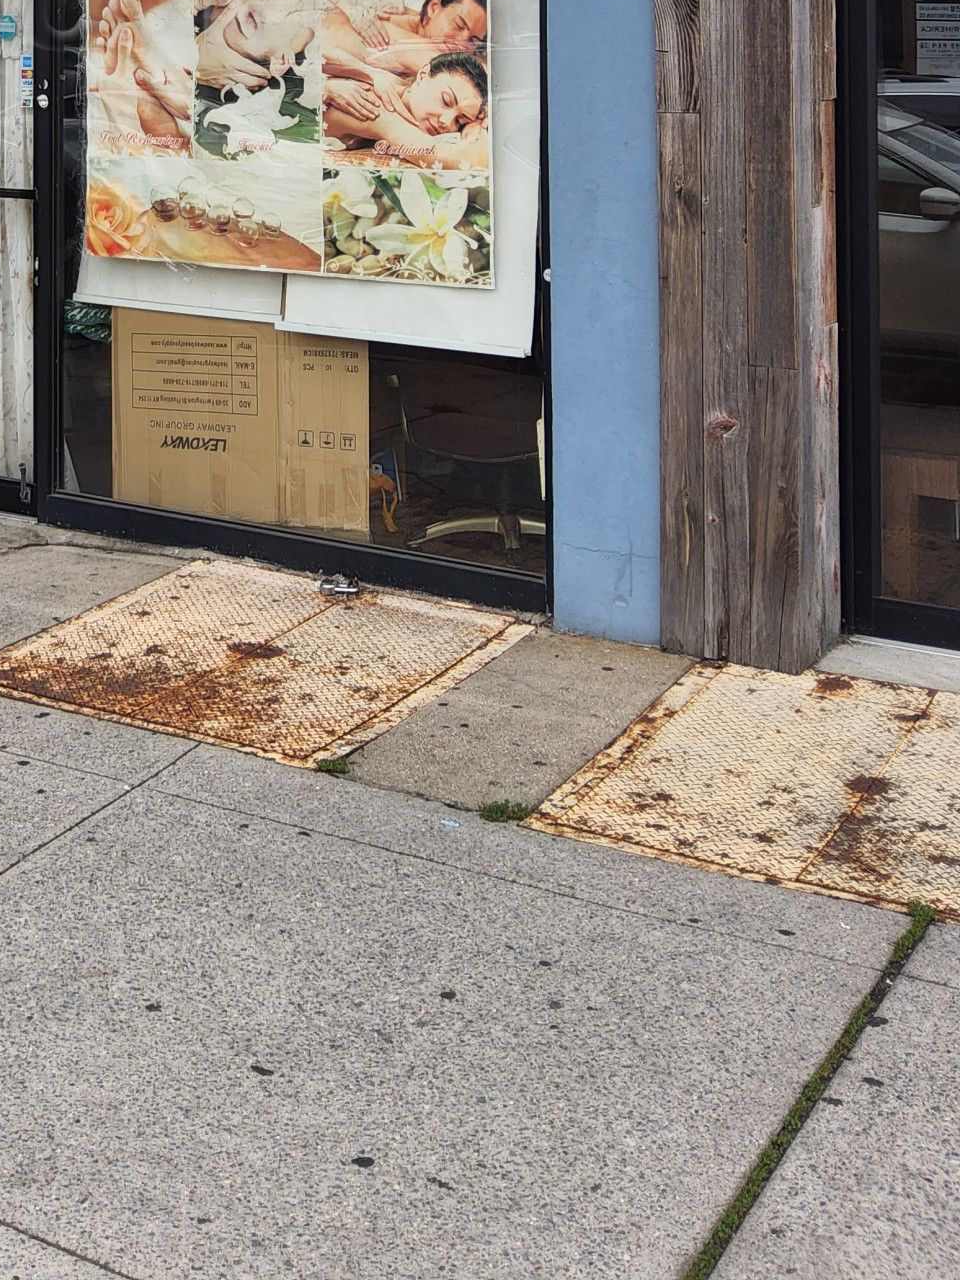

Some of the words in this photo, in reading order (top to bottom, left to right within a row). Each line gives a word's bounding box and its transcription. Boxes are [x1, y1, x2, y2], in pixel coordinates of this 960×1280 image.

[236, 136, 275, 152] Facial
[372, 140, 436, 158] Bodywork
[234, 362, 255, 370] E-MAIL
[303, 363, 315, 371] PCS
[239, 381, 250, 389] TEL
[150, 420, 164, 429] INC
[165, 421, 194, 431] GROUP
[196, 423, 236, 433] LEADWAY
